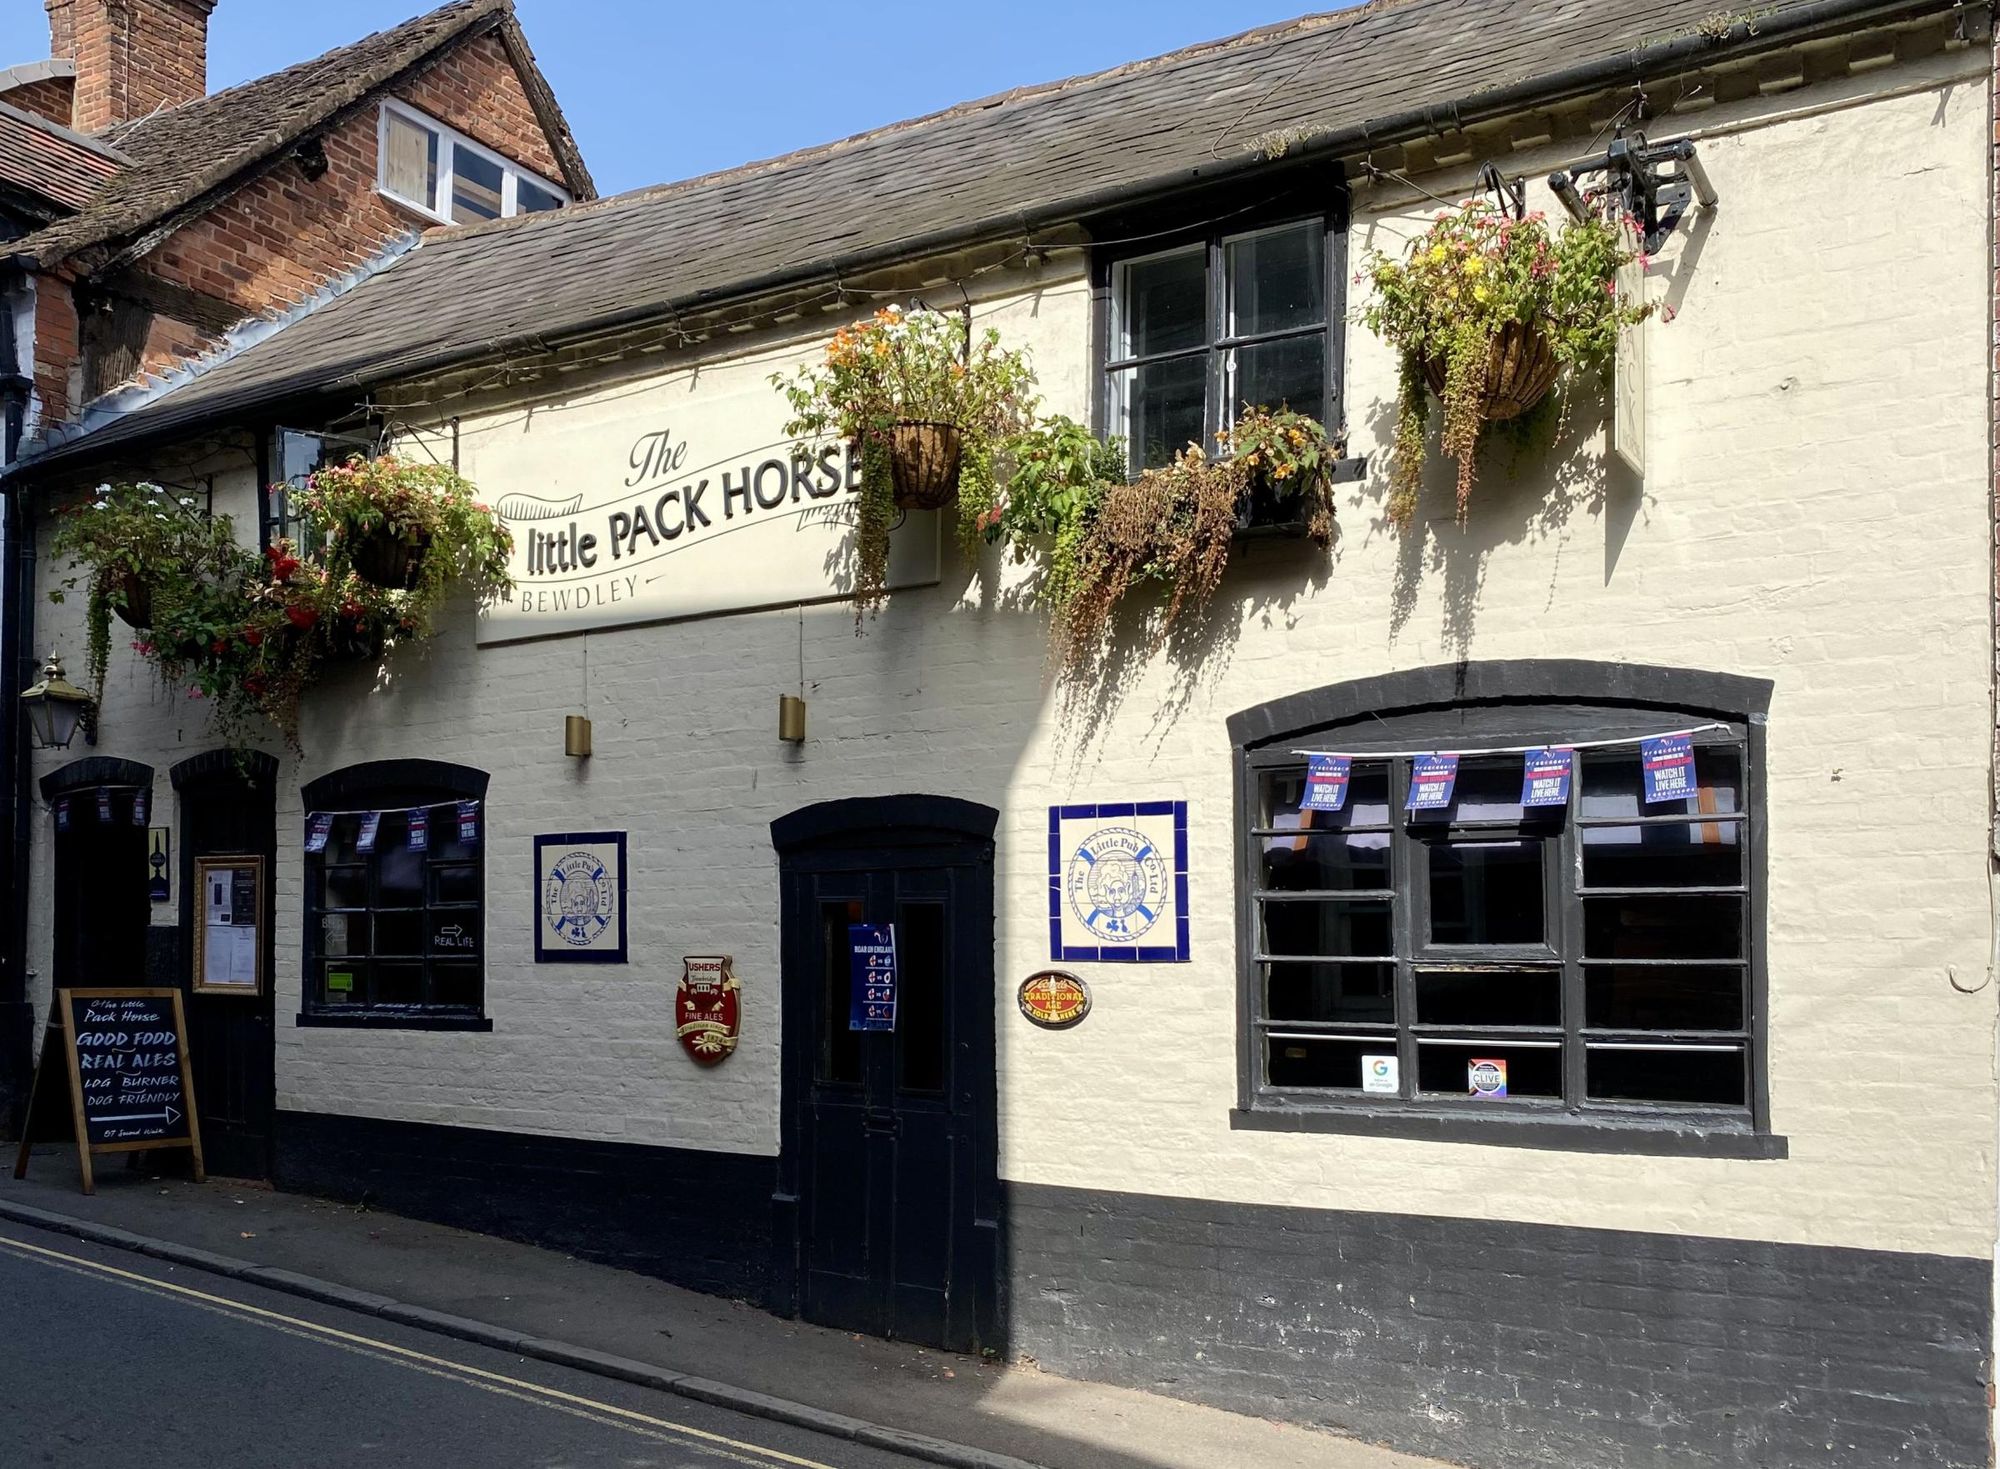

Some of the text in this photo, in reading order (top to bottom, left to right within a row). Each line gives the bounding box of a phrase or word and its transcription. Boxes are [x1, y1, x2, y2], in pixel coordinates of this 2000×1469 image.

[625, 428, 688, 487] The
[527, 442, 863, 576] little PACK HORSE
[521, 574, 640, 612] BEWDLEY
[1654, 766, 1685, 780] WATCH IT
[1655, 780, 1670, 791] LIVE
[561, 861, 581, 875] Little
[1074, 870, 1085, 892] The
[1090, 838, 1119, 856] Little
[1120, 838, 1139, 853] Pub
[434, 935, 475, 948] REAL LIFE
[688, 962, 721, 972] USHERS
[1024, 992, 1084, 1002] TRADITIONAL
[1045, 1001, 1062, 1009] ALE
[84, 1008, 160, 1022] Pack Horse
[684, 1012, 723, 1021] FINE ALES
[1032, 1009, 1049, 1019] SOLD
[77, 1031, 176, 1046] GOOD FOOD
[81, 1052, 176, 1069] REAL ALES
[84, 1075, 179, 1088] LOG BURNER
[1473, 1074, 1501, 1083] CLIVE
[87, 1092, 180, 1106] DOG FRIENDLY
